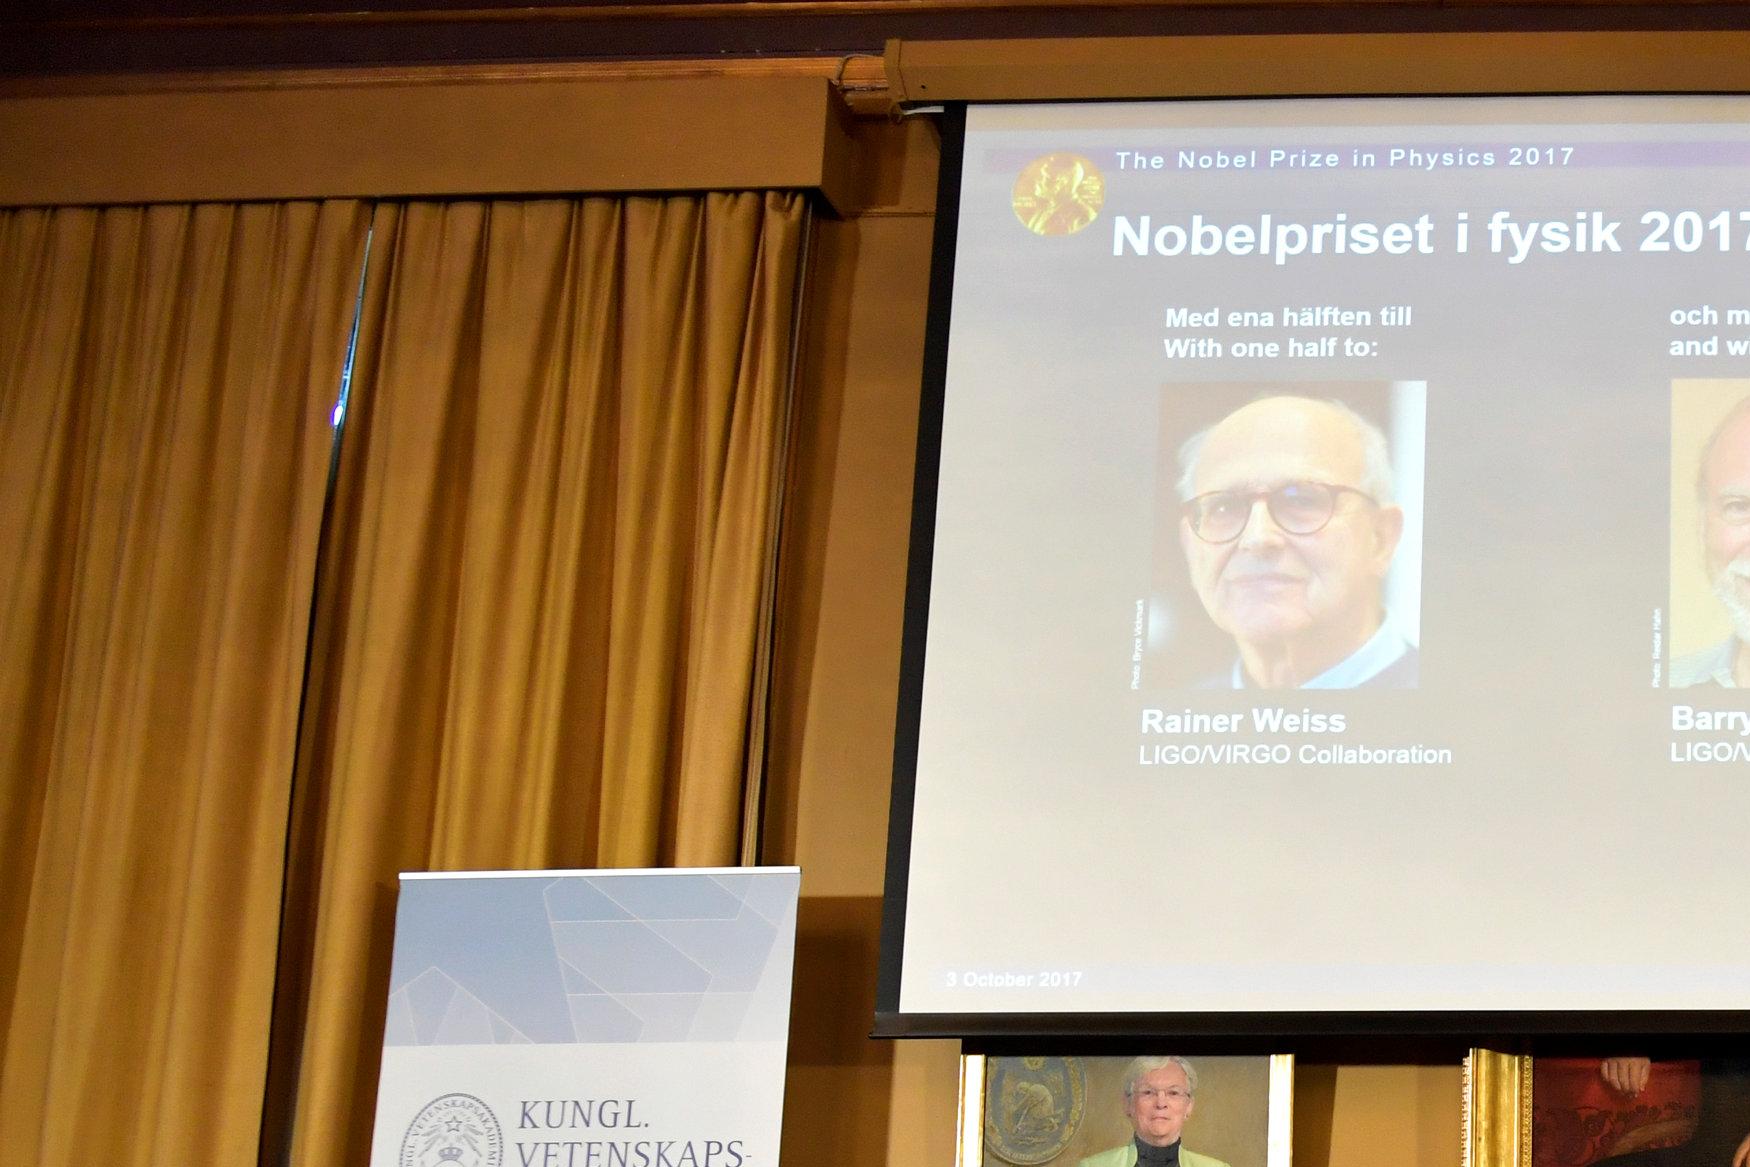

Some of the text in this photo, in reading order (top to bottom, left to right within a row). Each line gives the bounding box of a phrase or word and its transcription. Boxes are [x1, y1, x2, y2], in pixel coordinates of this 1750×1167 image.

[1115, 147, 1574, 171] The Nobel Prize in Physics 2017
[1113, 213, 1434, 266] Nobelpriset
[1456, 212, 1469, 253] i
[1487, 211, 1622, 264] fysik
[1165, 305, 1412, 328] Med ena hälften till
[1670, 304, 1719, 326] och
[1163, 336, 1378, 359] With one half to:
[1669, 335, 1719, 356] and
[1141, 707, 1347, 734] Rainer Weiss
[1139, 743, 1452, 765] LIGO/VIRGO Collaboration
[943, 971, 1083, 988] 3 October 2017
[518, 1099, 649, 1129] KUNGL.
